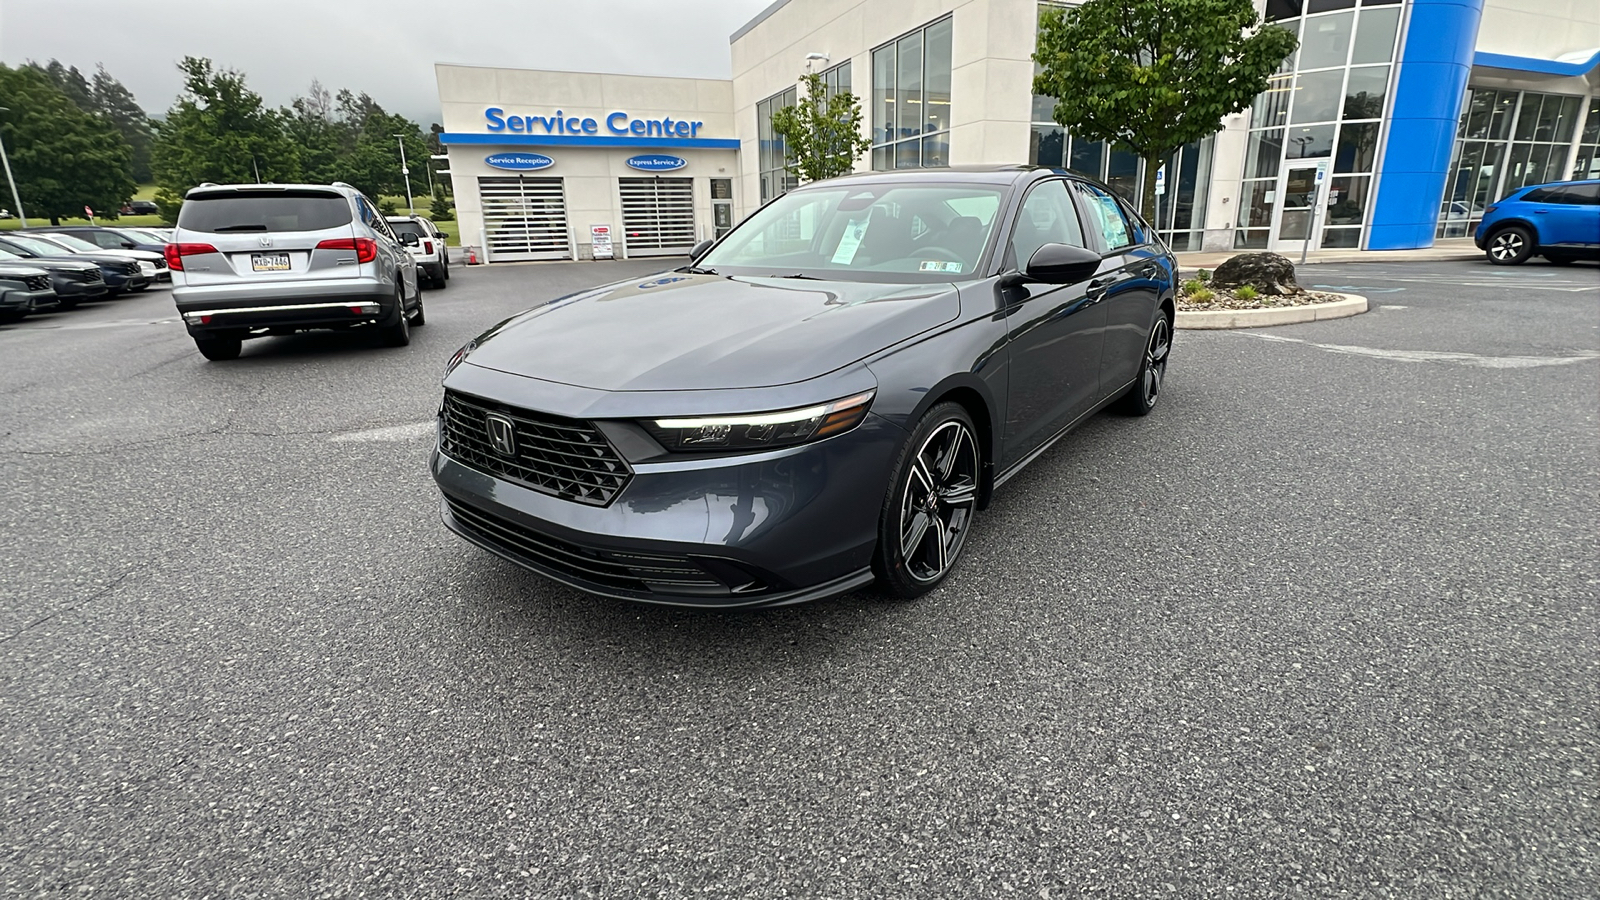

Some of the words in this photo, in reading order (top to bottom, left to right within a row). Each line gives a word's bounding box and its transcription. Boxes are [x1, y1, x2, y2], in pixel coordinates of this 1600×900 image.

[484, 107, 598, 134] Service
[606, 112, 703, 138] Center
[516, 157, 550, 165] Reception
